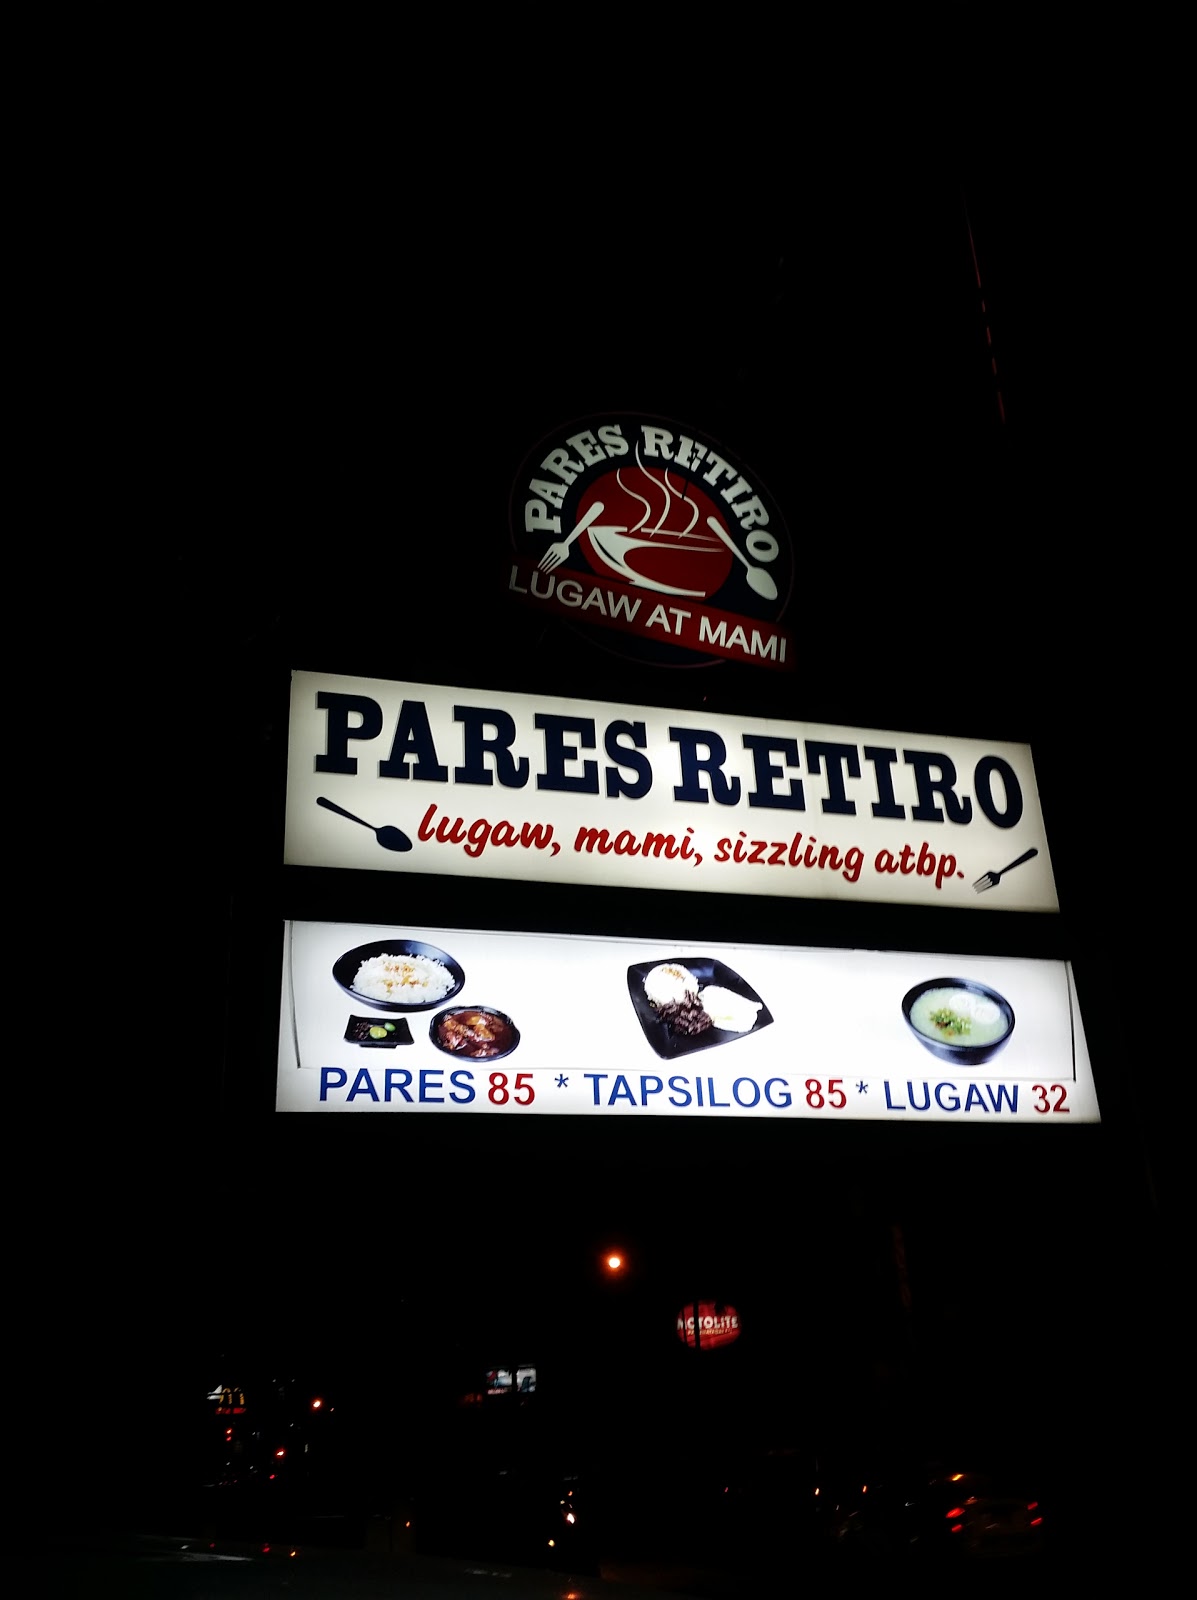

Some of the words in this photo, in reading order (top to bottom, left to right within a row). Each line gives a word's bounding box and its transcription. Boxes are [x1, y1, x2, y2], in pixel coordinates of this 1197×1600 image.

[524, 424, 629, 534] PARES
[640, 424, 780, 563] RETIRO
[508, 564, 642, 623] LUGAW
[645, 603, 692, 636] AT
[698, 615, 787, 663] MAMI
[314, 690, 653, 801] PARES
[668, 726, 1024, 829] RETIRO
[417, 803, 561, 858] lugaw,
[573, 826, 704, 868] mami,
[714, 830, 866, 883] sizzling
[874, 841, 965, 889] atbp.
[319, 1066, 476, 1103] PARES
[487, 1072, 535, 1106] 85
[583, 1072, 793, 1109] TAPSILOG
[804, 1078, 847, 1109] 85
[884, 1080, 1019, 1113] LUGAW
[1031, 1084, 1071, 1114] 32
